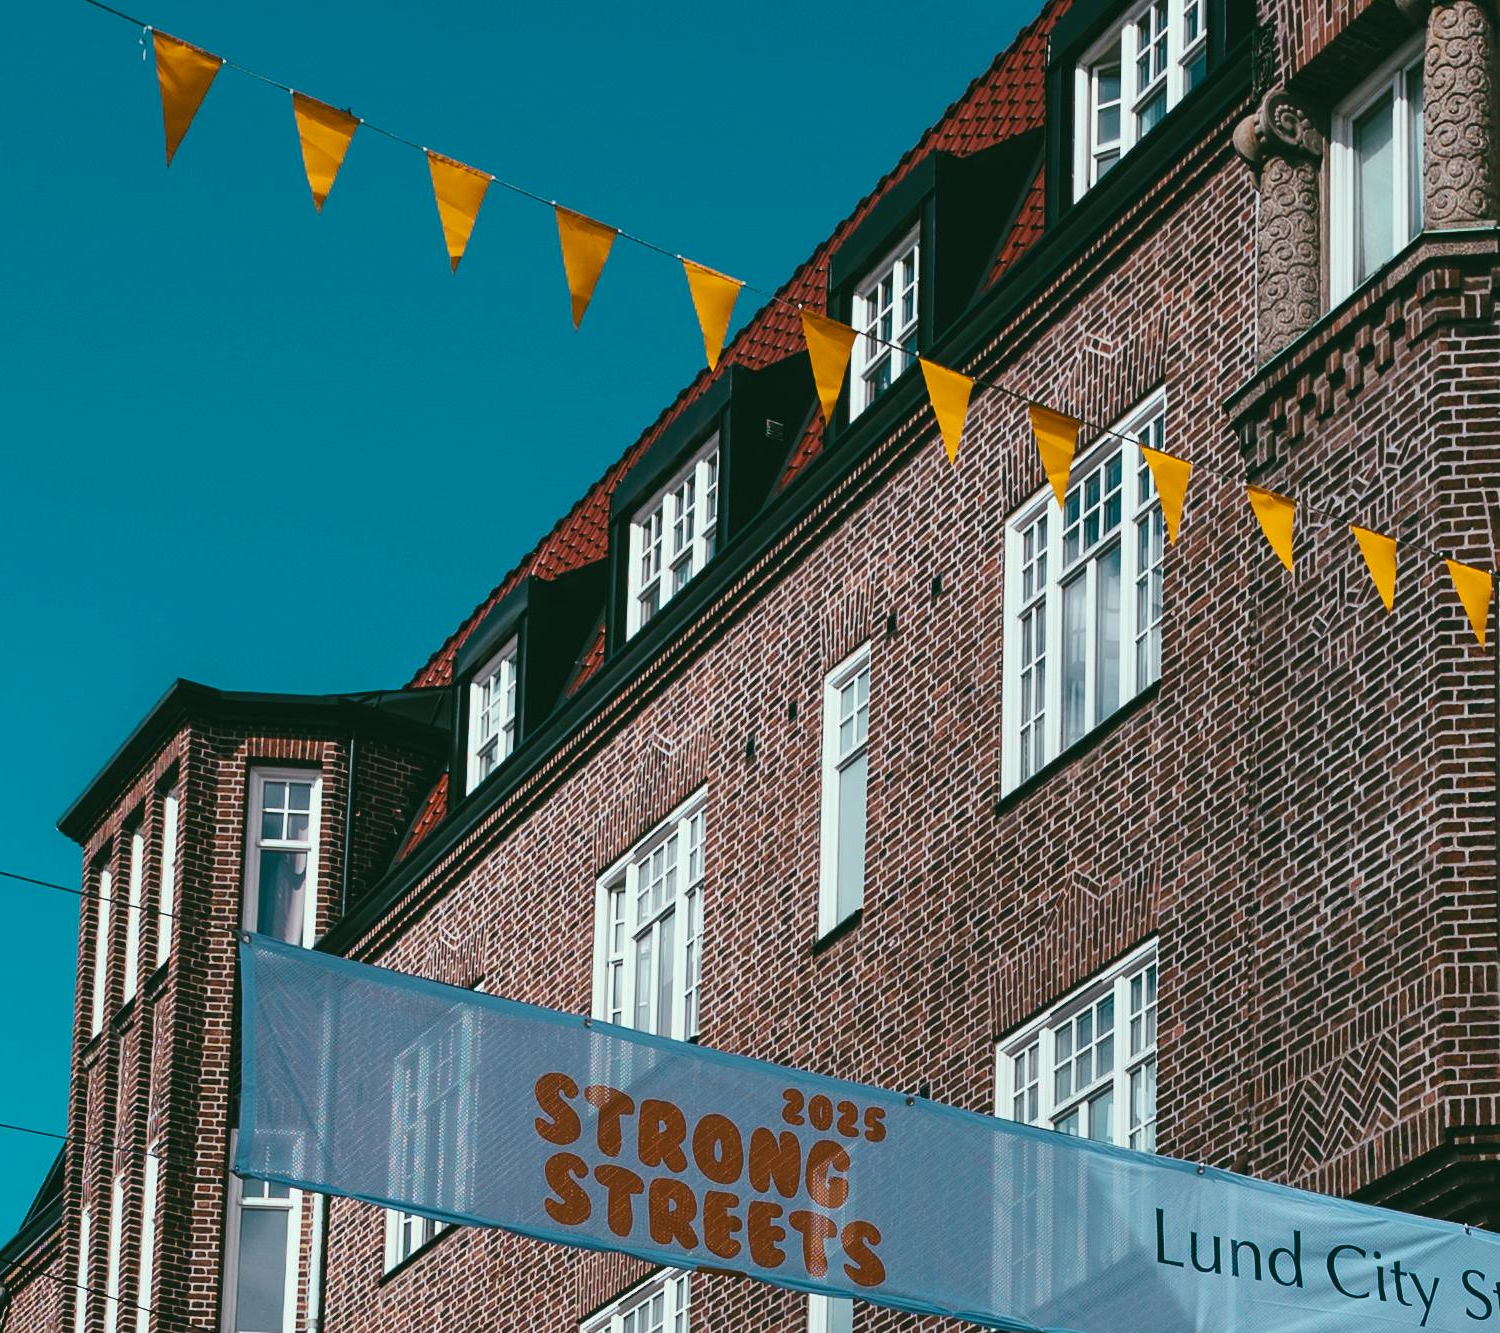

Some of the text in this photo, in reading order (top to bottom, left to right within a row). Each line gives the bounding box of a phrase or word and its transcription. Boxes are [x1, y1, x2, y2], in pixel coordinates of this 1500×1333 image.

[534, 1072, 852, 1209] STRONG
[781, 1087, 887, 1143] 2025
[543, 1151, 886, 1287] STREETS
[1154, 1207, 1305, 1288] Lund
[1325, 1243, 1441, 1328] City
